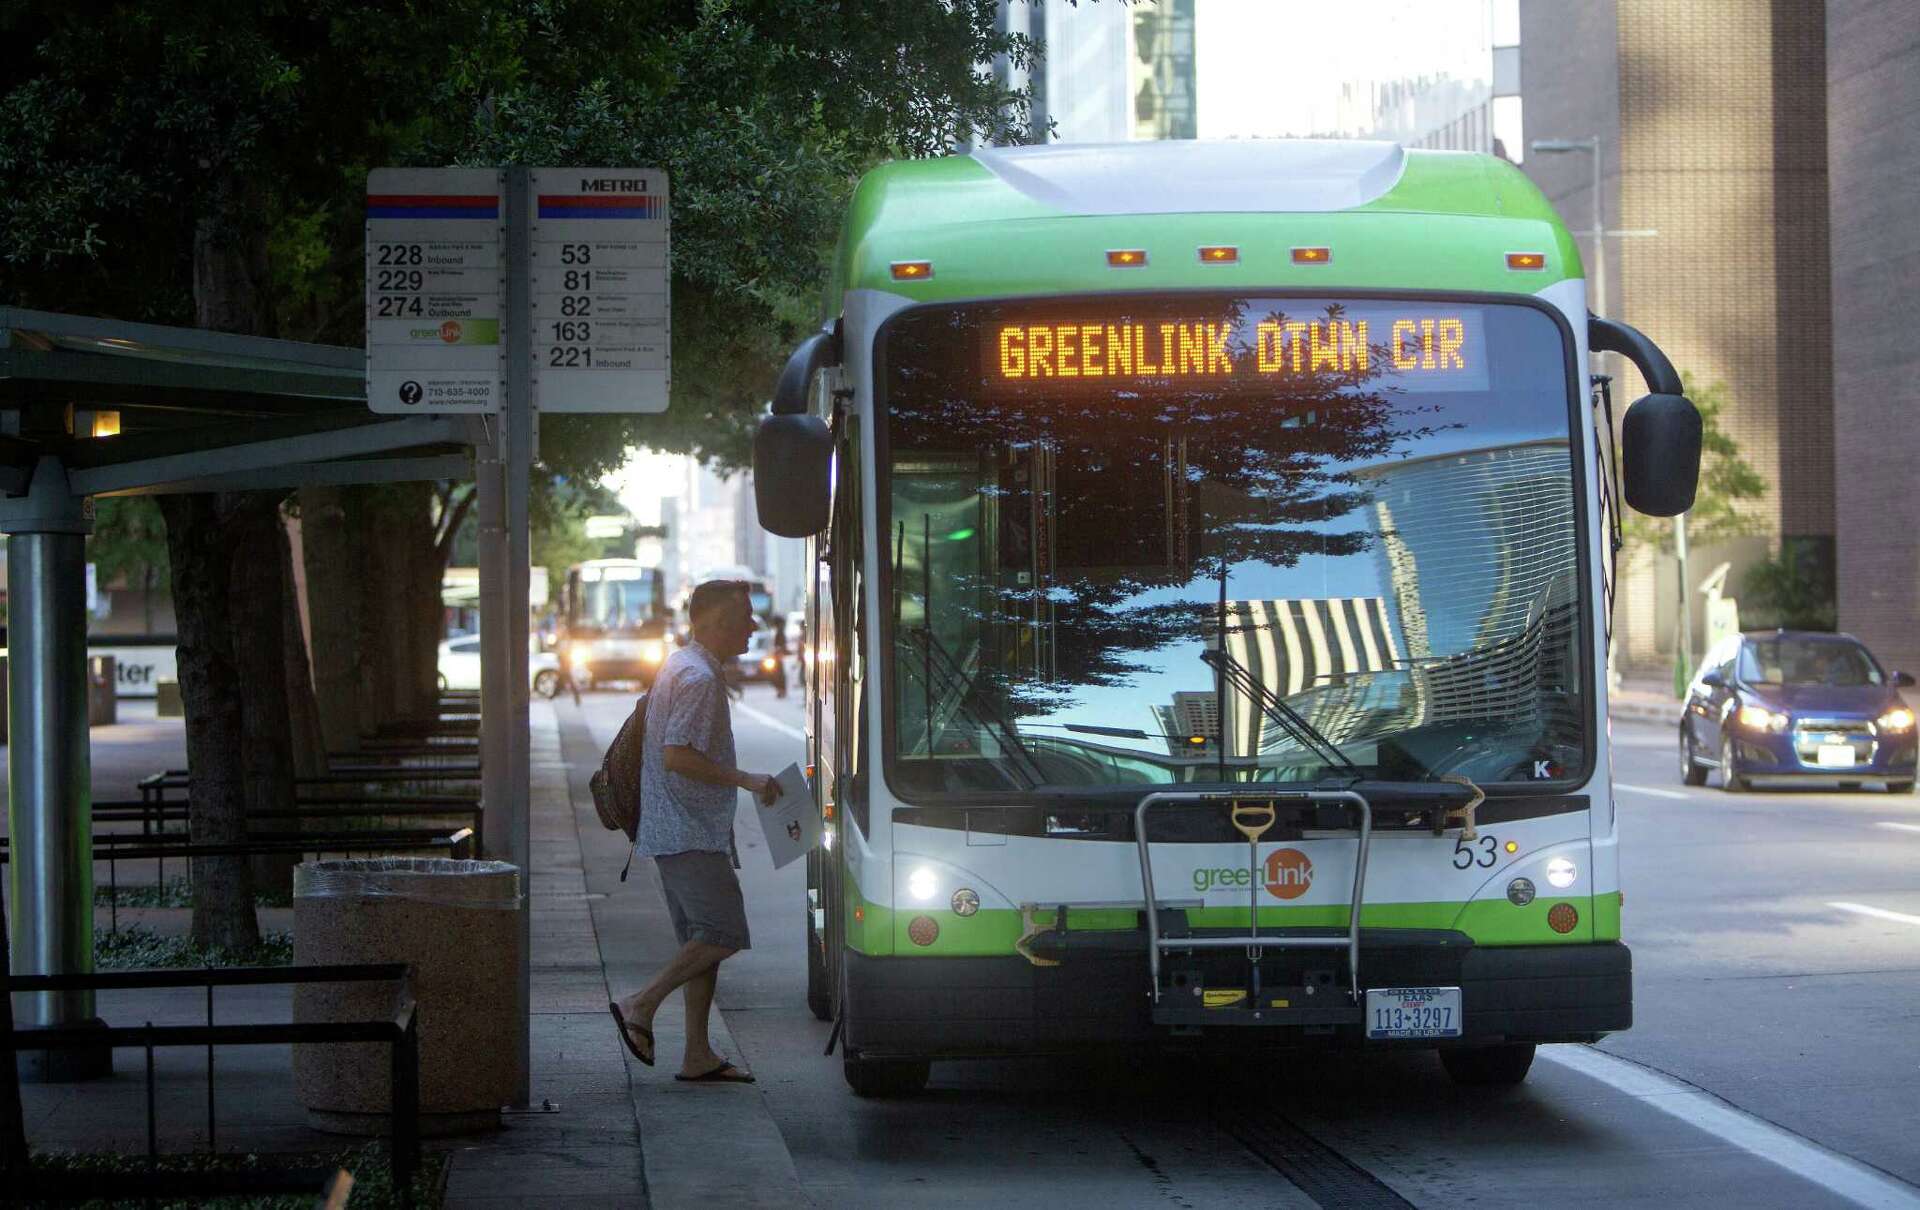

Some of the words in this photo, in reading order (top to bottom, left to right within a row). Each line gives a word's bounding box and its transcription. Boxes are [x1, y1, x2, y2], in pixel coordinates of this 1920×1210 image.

[581, 179, 648, 193] METRO
[378, 245, 422, 266] 228
[427, 255, 465, 265] Inbound
[561, 245, 591, 265] 53
[378, 270, 423, 291] 229
[564, 270, 591, 291] 81
[378, 296, 424, 317] 274
[428, 307, 472, 318] Outbound
[561, 296, 591, 317] 82
[552, 321, 591, 342] 163
[550, 347, 591, 368] 221
[998, 323, 1233, 378] GREENLINK
[1257, 320, 1369, 374] DTWN
[1392, 318, 1465, 370] CIR
[596, 359, 632, 368] Inbound
[1453, 835, 1498, 870] 53
[1193, 862, 1314, 891] greenLink
[1397, 994, 1434, 1002] TEXAS
